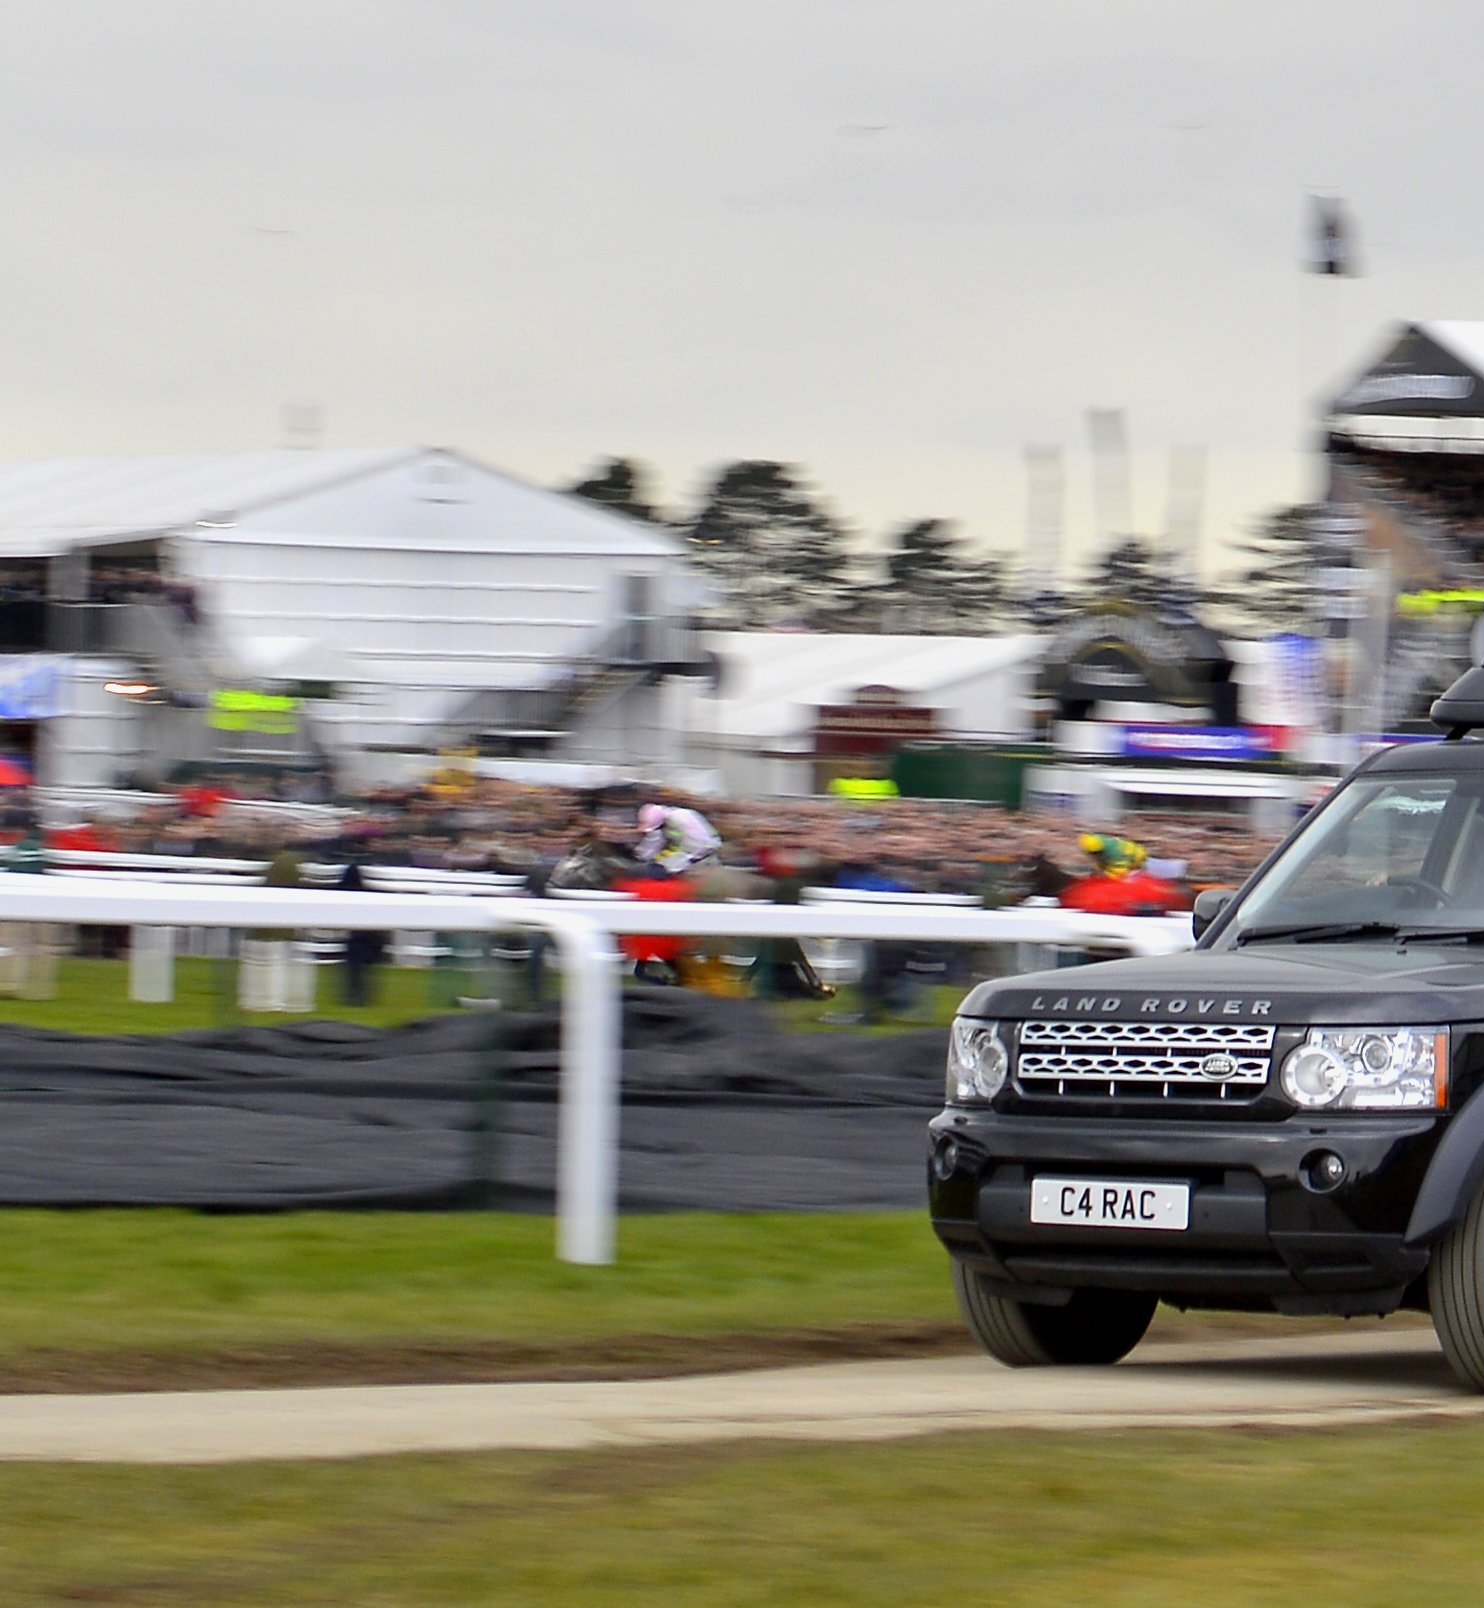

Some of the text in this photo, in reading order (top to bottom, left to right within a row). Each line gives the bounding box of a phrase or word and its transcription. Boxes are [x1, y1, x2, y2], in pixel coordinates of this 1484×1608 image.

[1031, 996, 1273, 1016] LAND ROVER
[1060, 1187, 1156, 1220] C4 RAC
